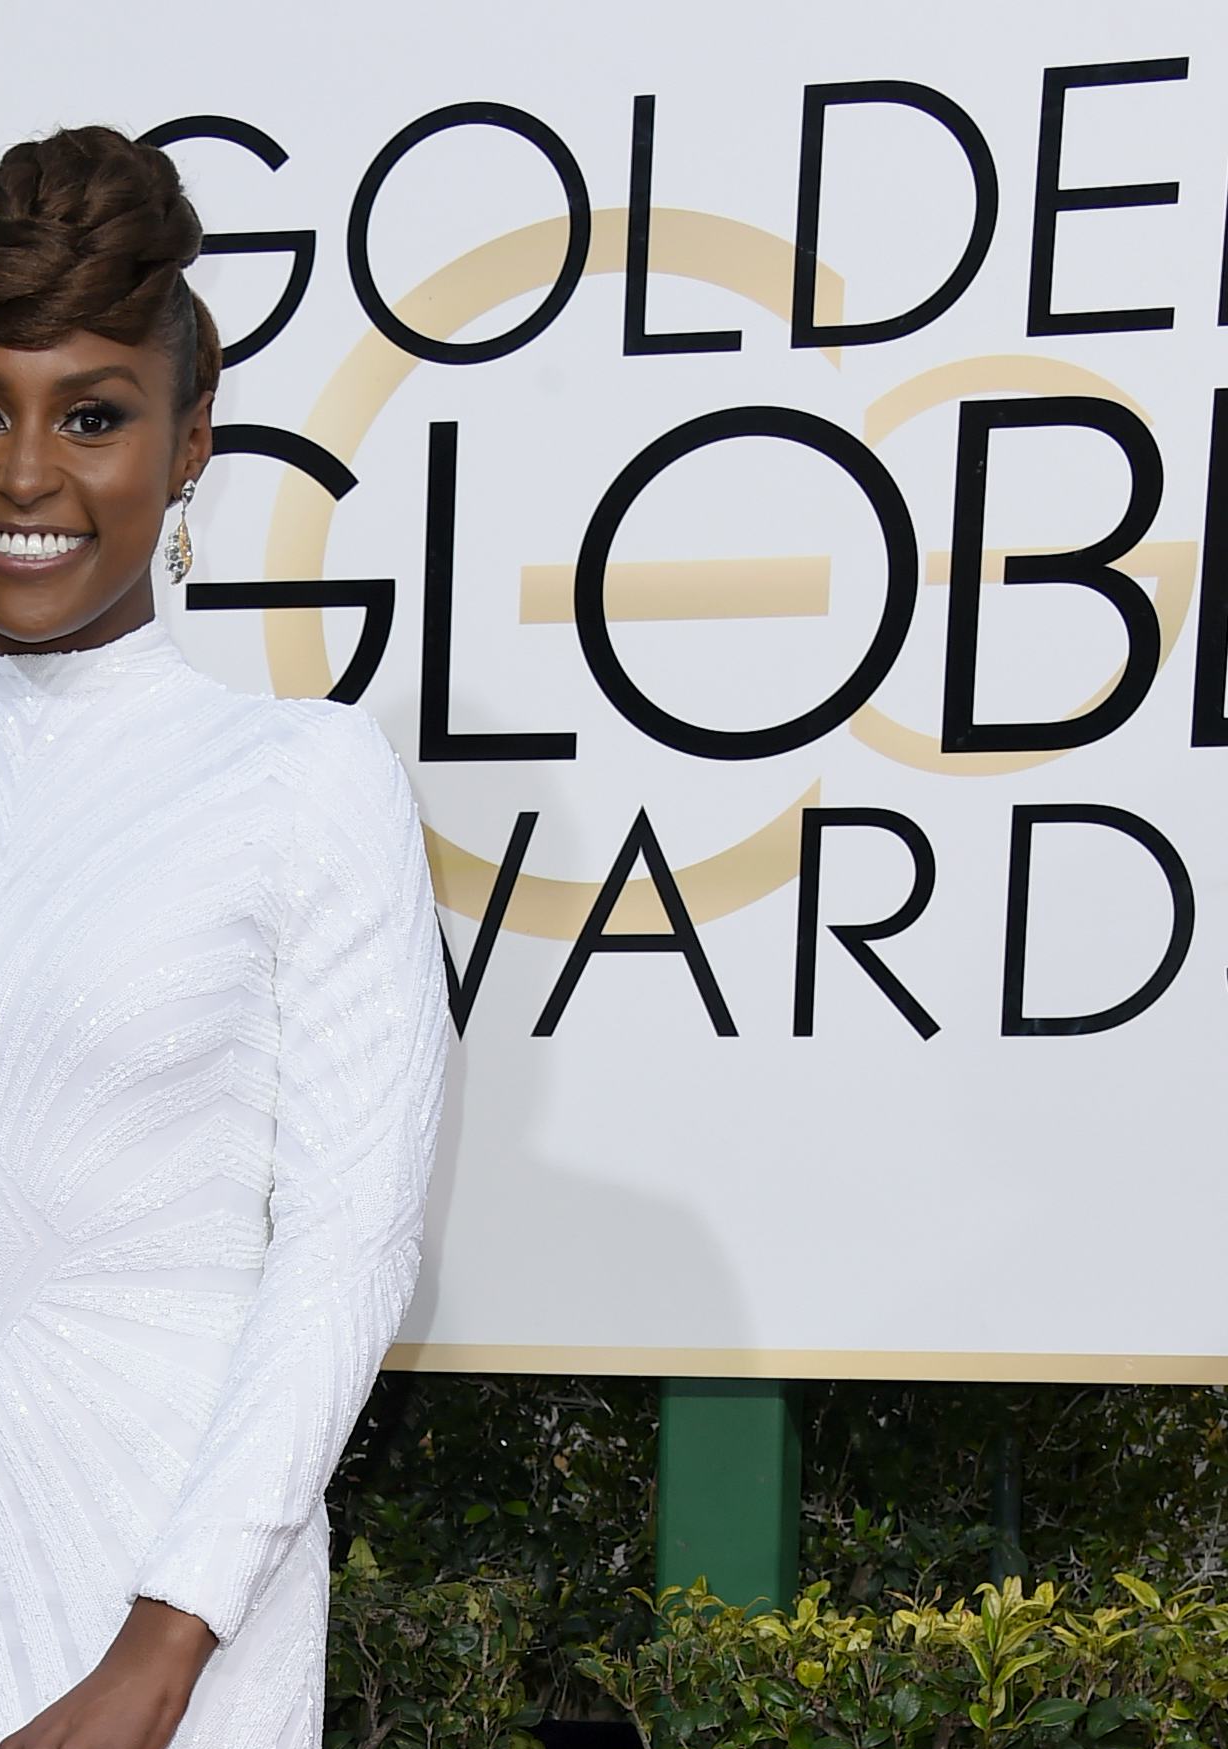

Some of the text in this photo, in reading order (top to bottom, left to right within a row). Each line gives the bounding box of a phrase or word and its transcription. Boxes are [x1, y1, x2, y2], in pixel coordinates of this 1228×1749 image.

[134, 57, 1228, 366] GOLDE
[186, 388, 1228, 762] GLOB
[434, 804, 1228, 1040] ARD
